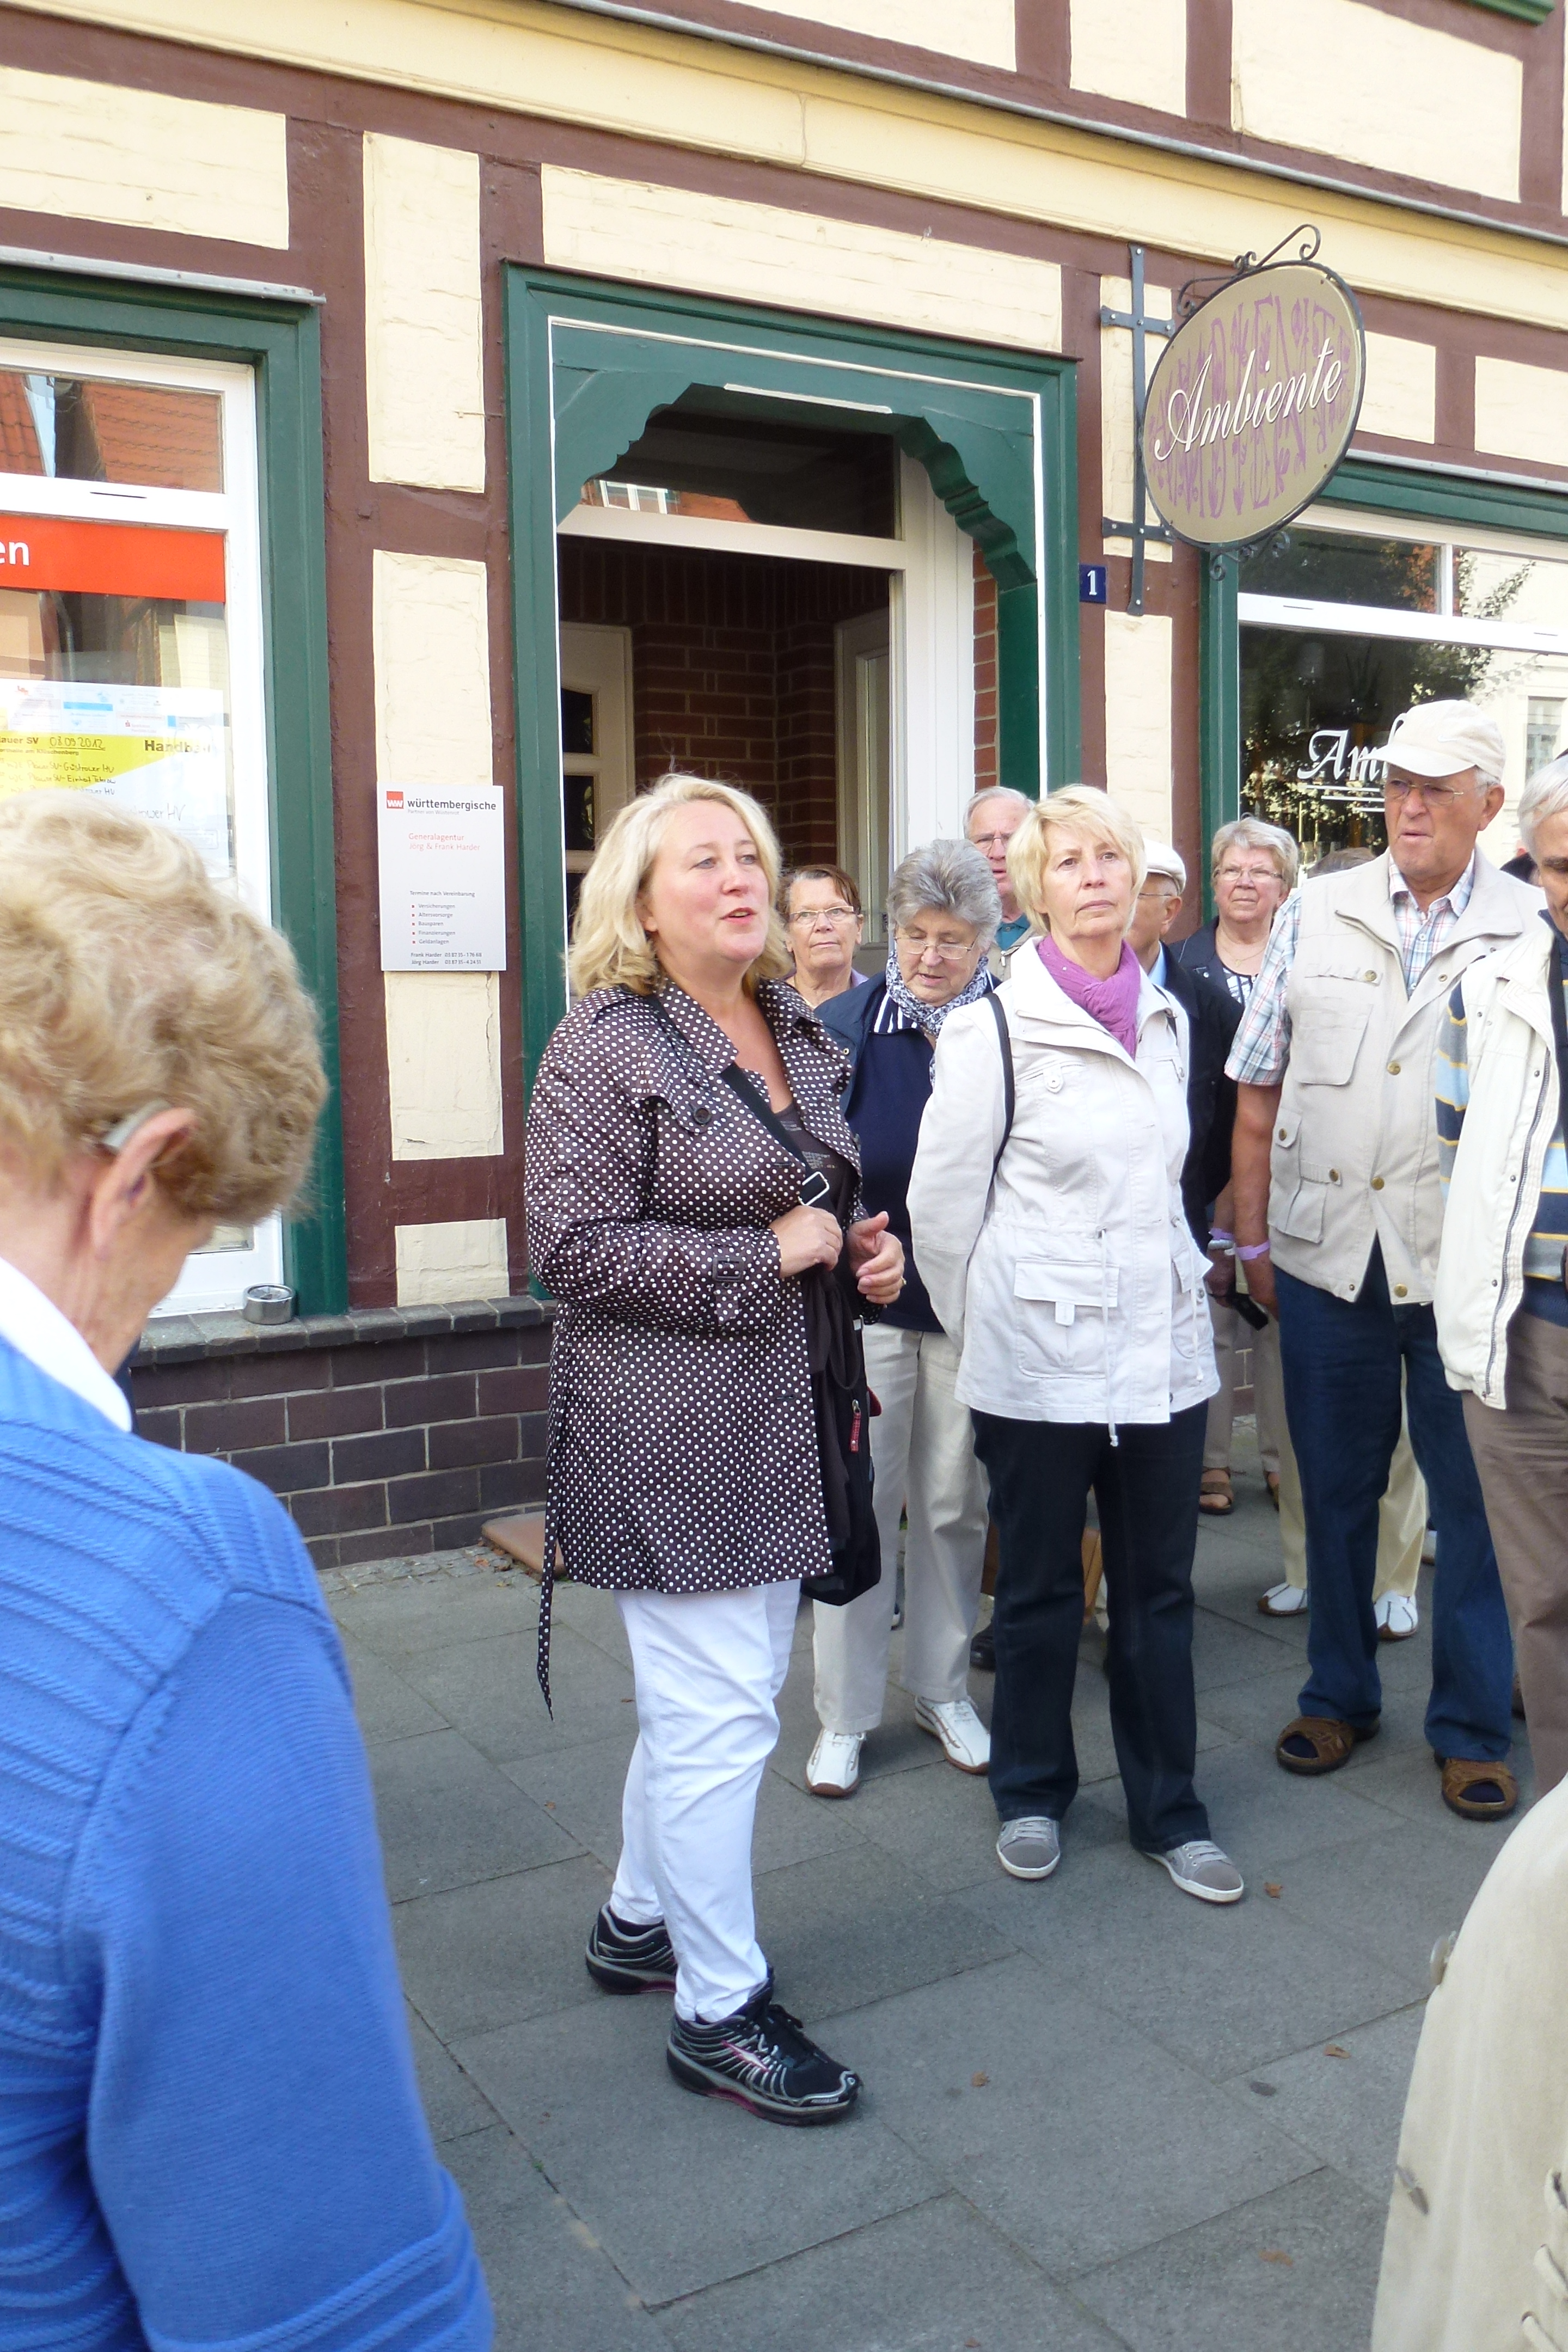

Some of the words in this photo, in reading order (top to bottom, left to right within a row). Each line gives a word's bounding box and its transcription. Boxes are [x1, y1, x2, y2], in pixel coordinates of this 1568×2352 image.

[1154, 338, 1343, 461] Ambiente
[1087, 570, 1097, 595] 1
[144, 740, 210, 753] Handbal
[407, 798, 497, 811] württembergische
[408, 833, 464, 842] Generalagentur
[409, 843, 424, 852] Jörg
